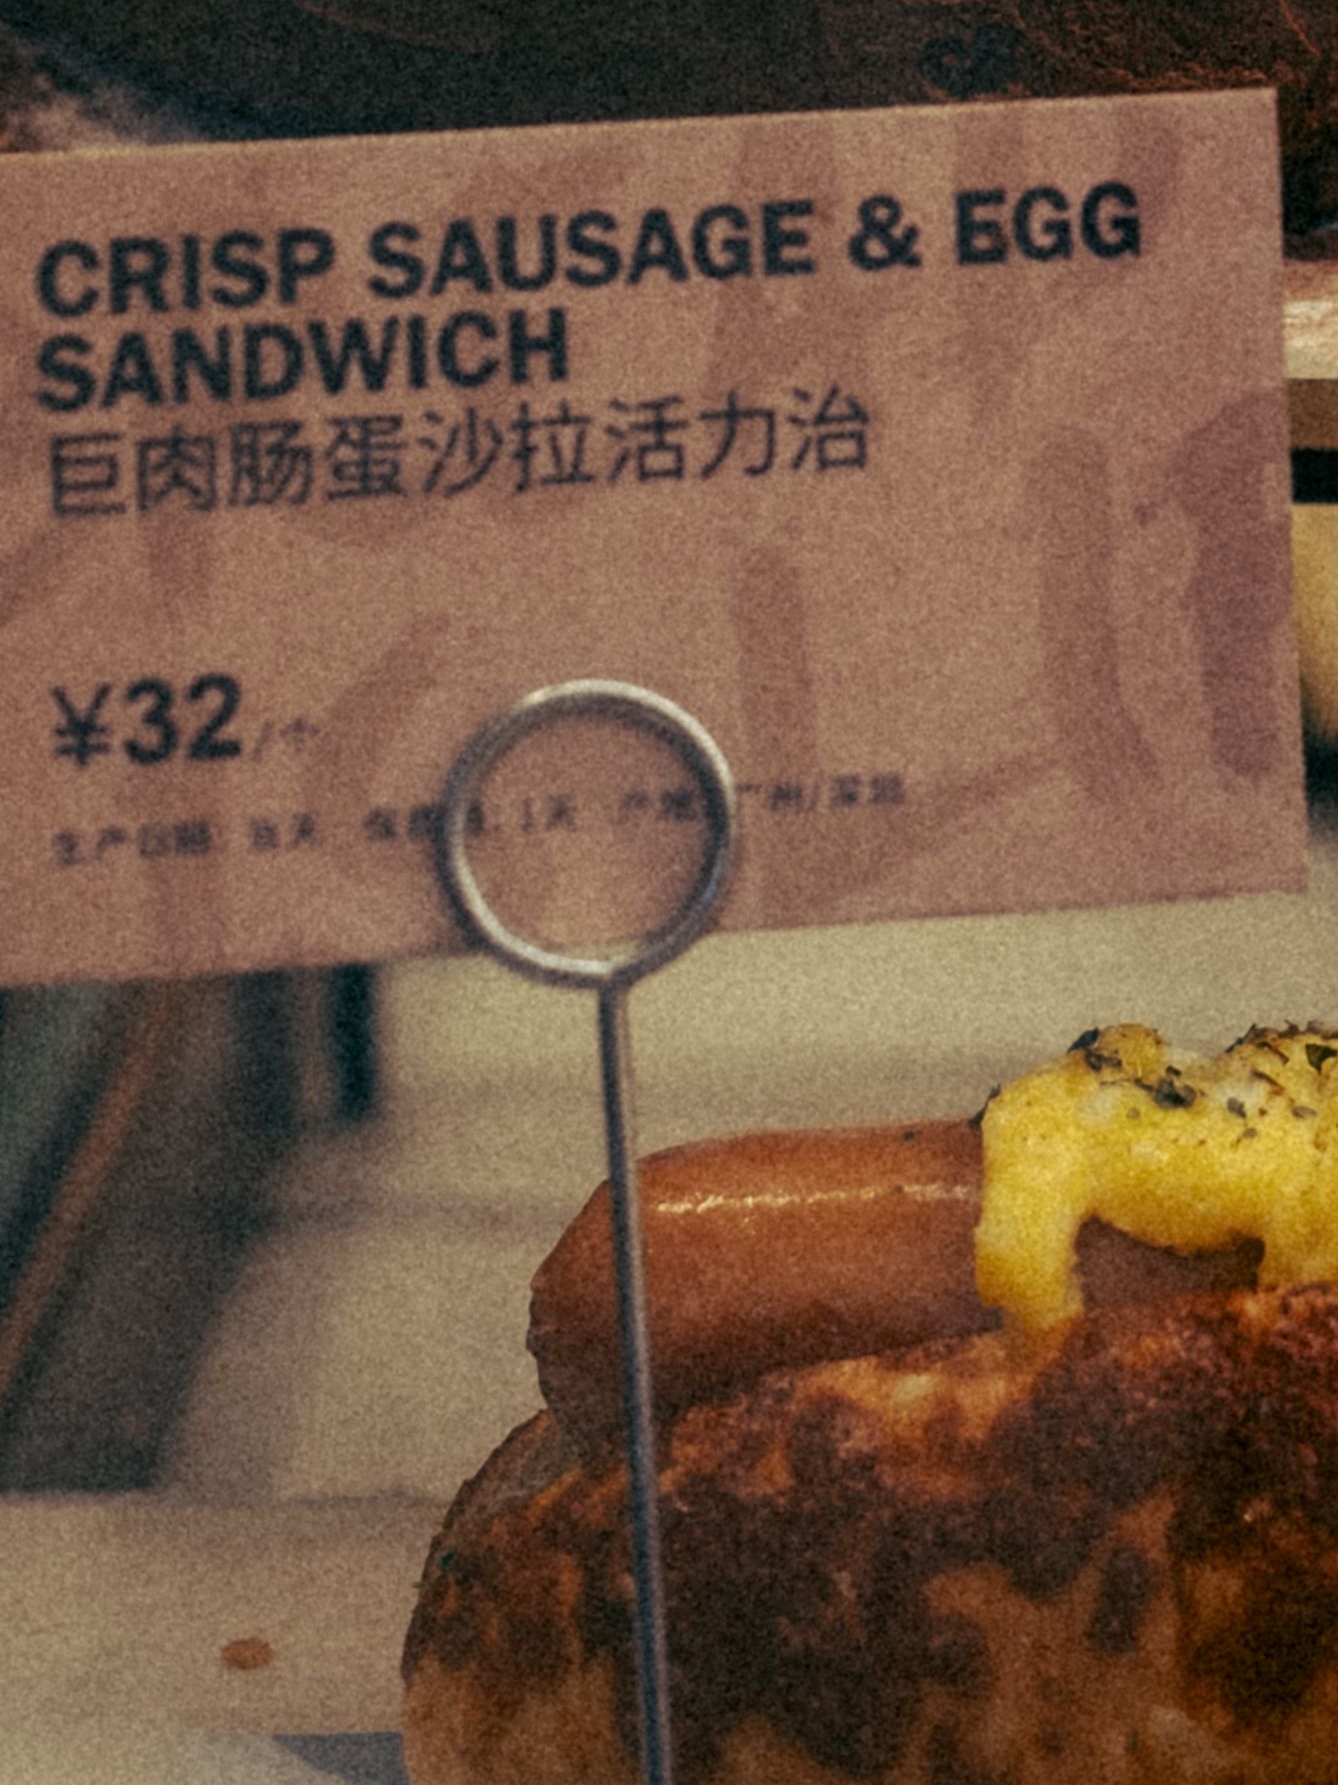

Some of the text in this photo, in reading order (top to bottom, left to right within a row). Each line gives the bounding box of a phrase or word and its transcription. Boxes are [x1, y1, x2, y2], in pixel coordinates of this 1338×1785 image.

[37, 181, 1141, 318] CRISP SAUSAGE & EGG
[34, 308, 567, 413] SANDWICH
[48, 385, 870, 520] 巨肉肠蛋沙拉活力治
